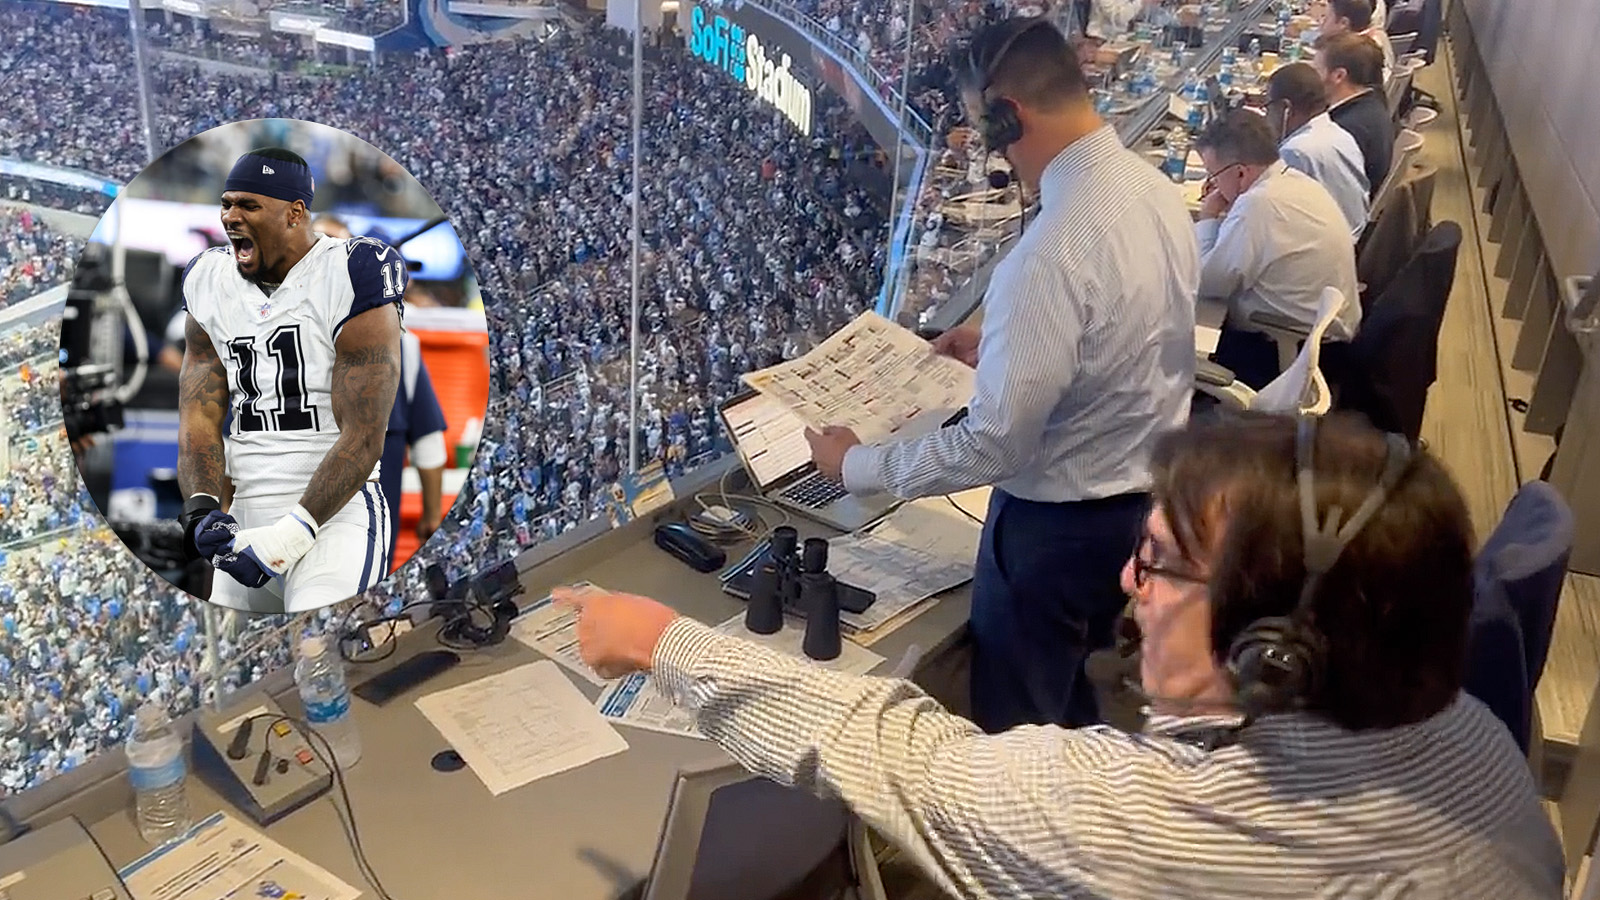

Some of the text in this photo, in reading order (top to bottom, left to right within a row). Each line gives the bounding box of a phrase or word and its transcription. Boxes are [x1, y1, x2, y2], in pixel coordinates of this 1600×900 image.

[690, 5, 811, 136] SoFi Stadium
[381, 260, 404, 299] 11
[226, 324, 320, 435] 11
